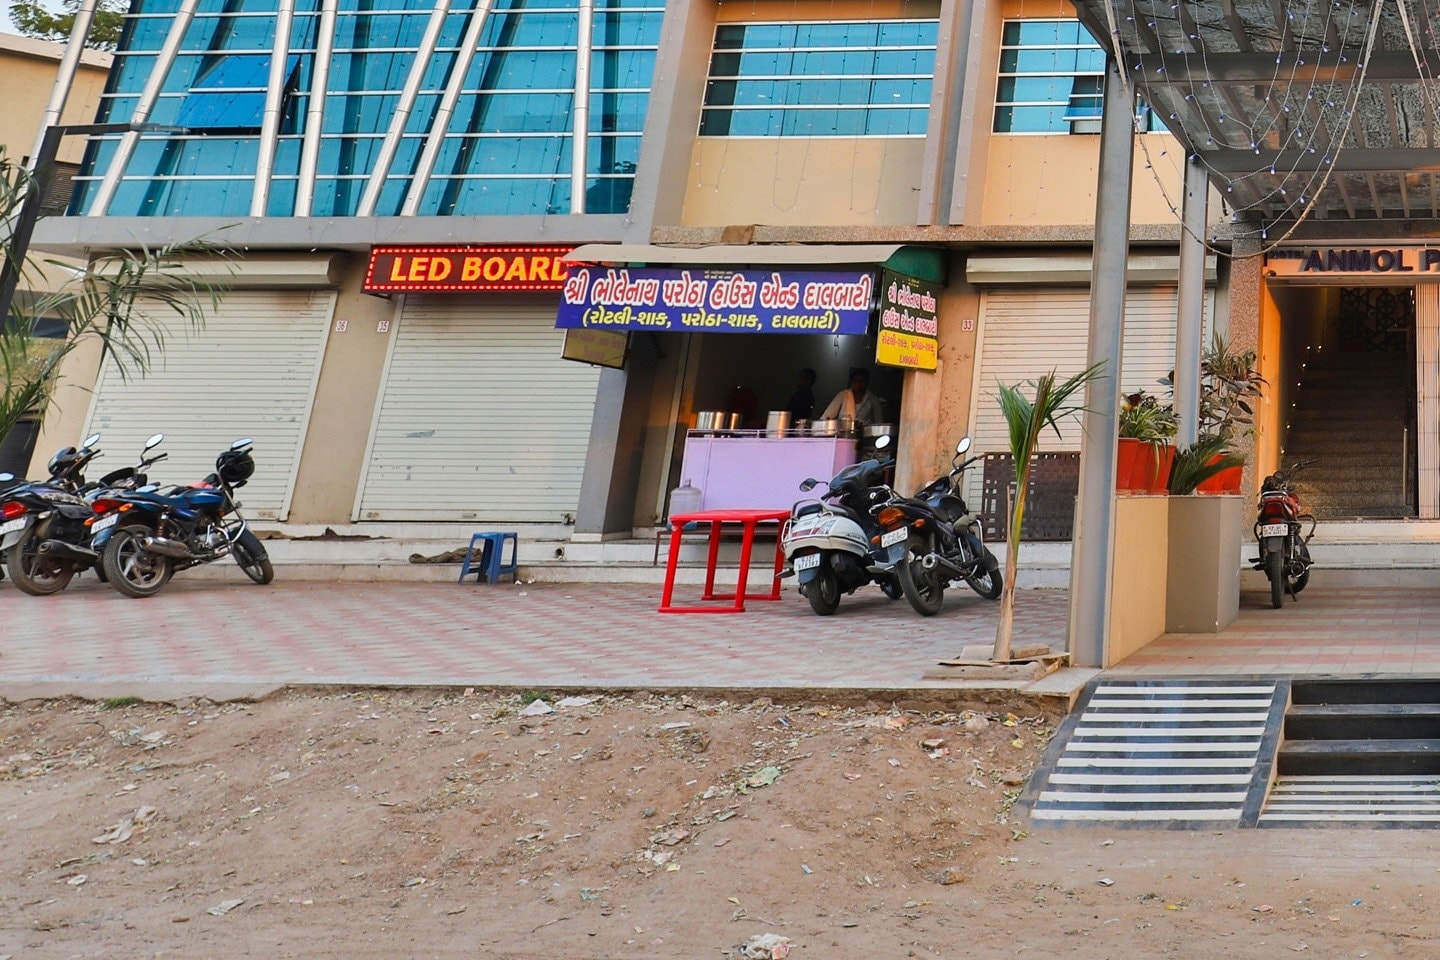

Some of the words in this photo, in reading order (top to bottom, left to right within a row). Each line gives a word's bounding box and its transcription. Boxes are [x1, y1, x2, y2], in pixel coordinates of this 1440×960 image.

[390, 257, 451, 281] LED
[1303, 249, 1413, 272] ANMOL
[564, 269, 590, 305] શ્રી
[591, 269, 659, 307] ભોલેનાથ
[662, 270, 704, 308] પરોઠા
[710, 273, 757, 309] હાઉસ
[760, 272, 799, 309] એન્ડ
[803, 273, 871, 311] દાલબાટી
[681, 308, 763, 330] પરોઠા-શાક,
[772, 310, 840, 332] દાલબાટી)
